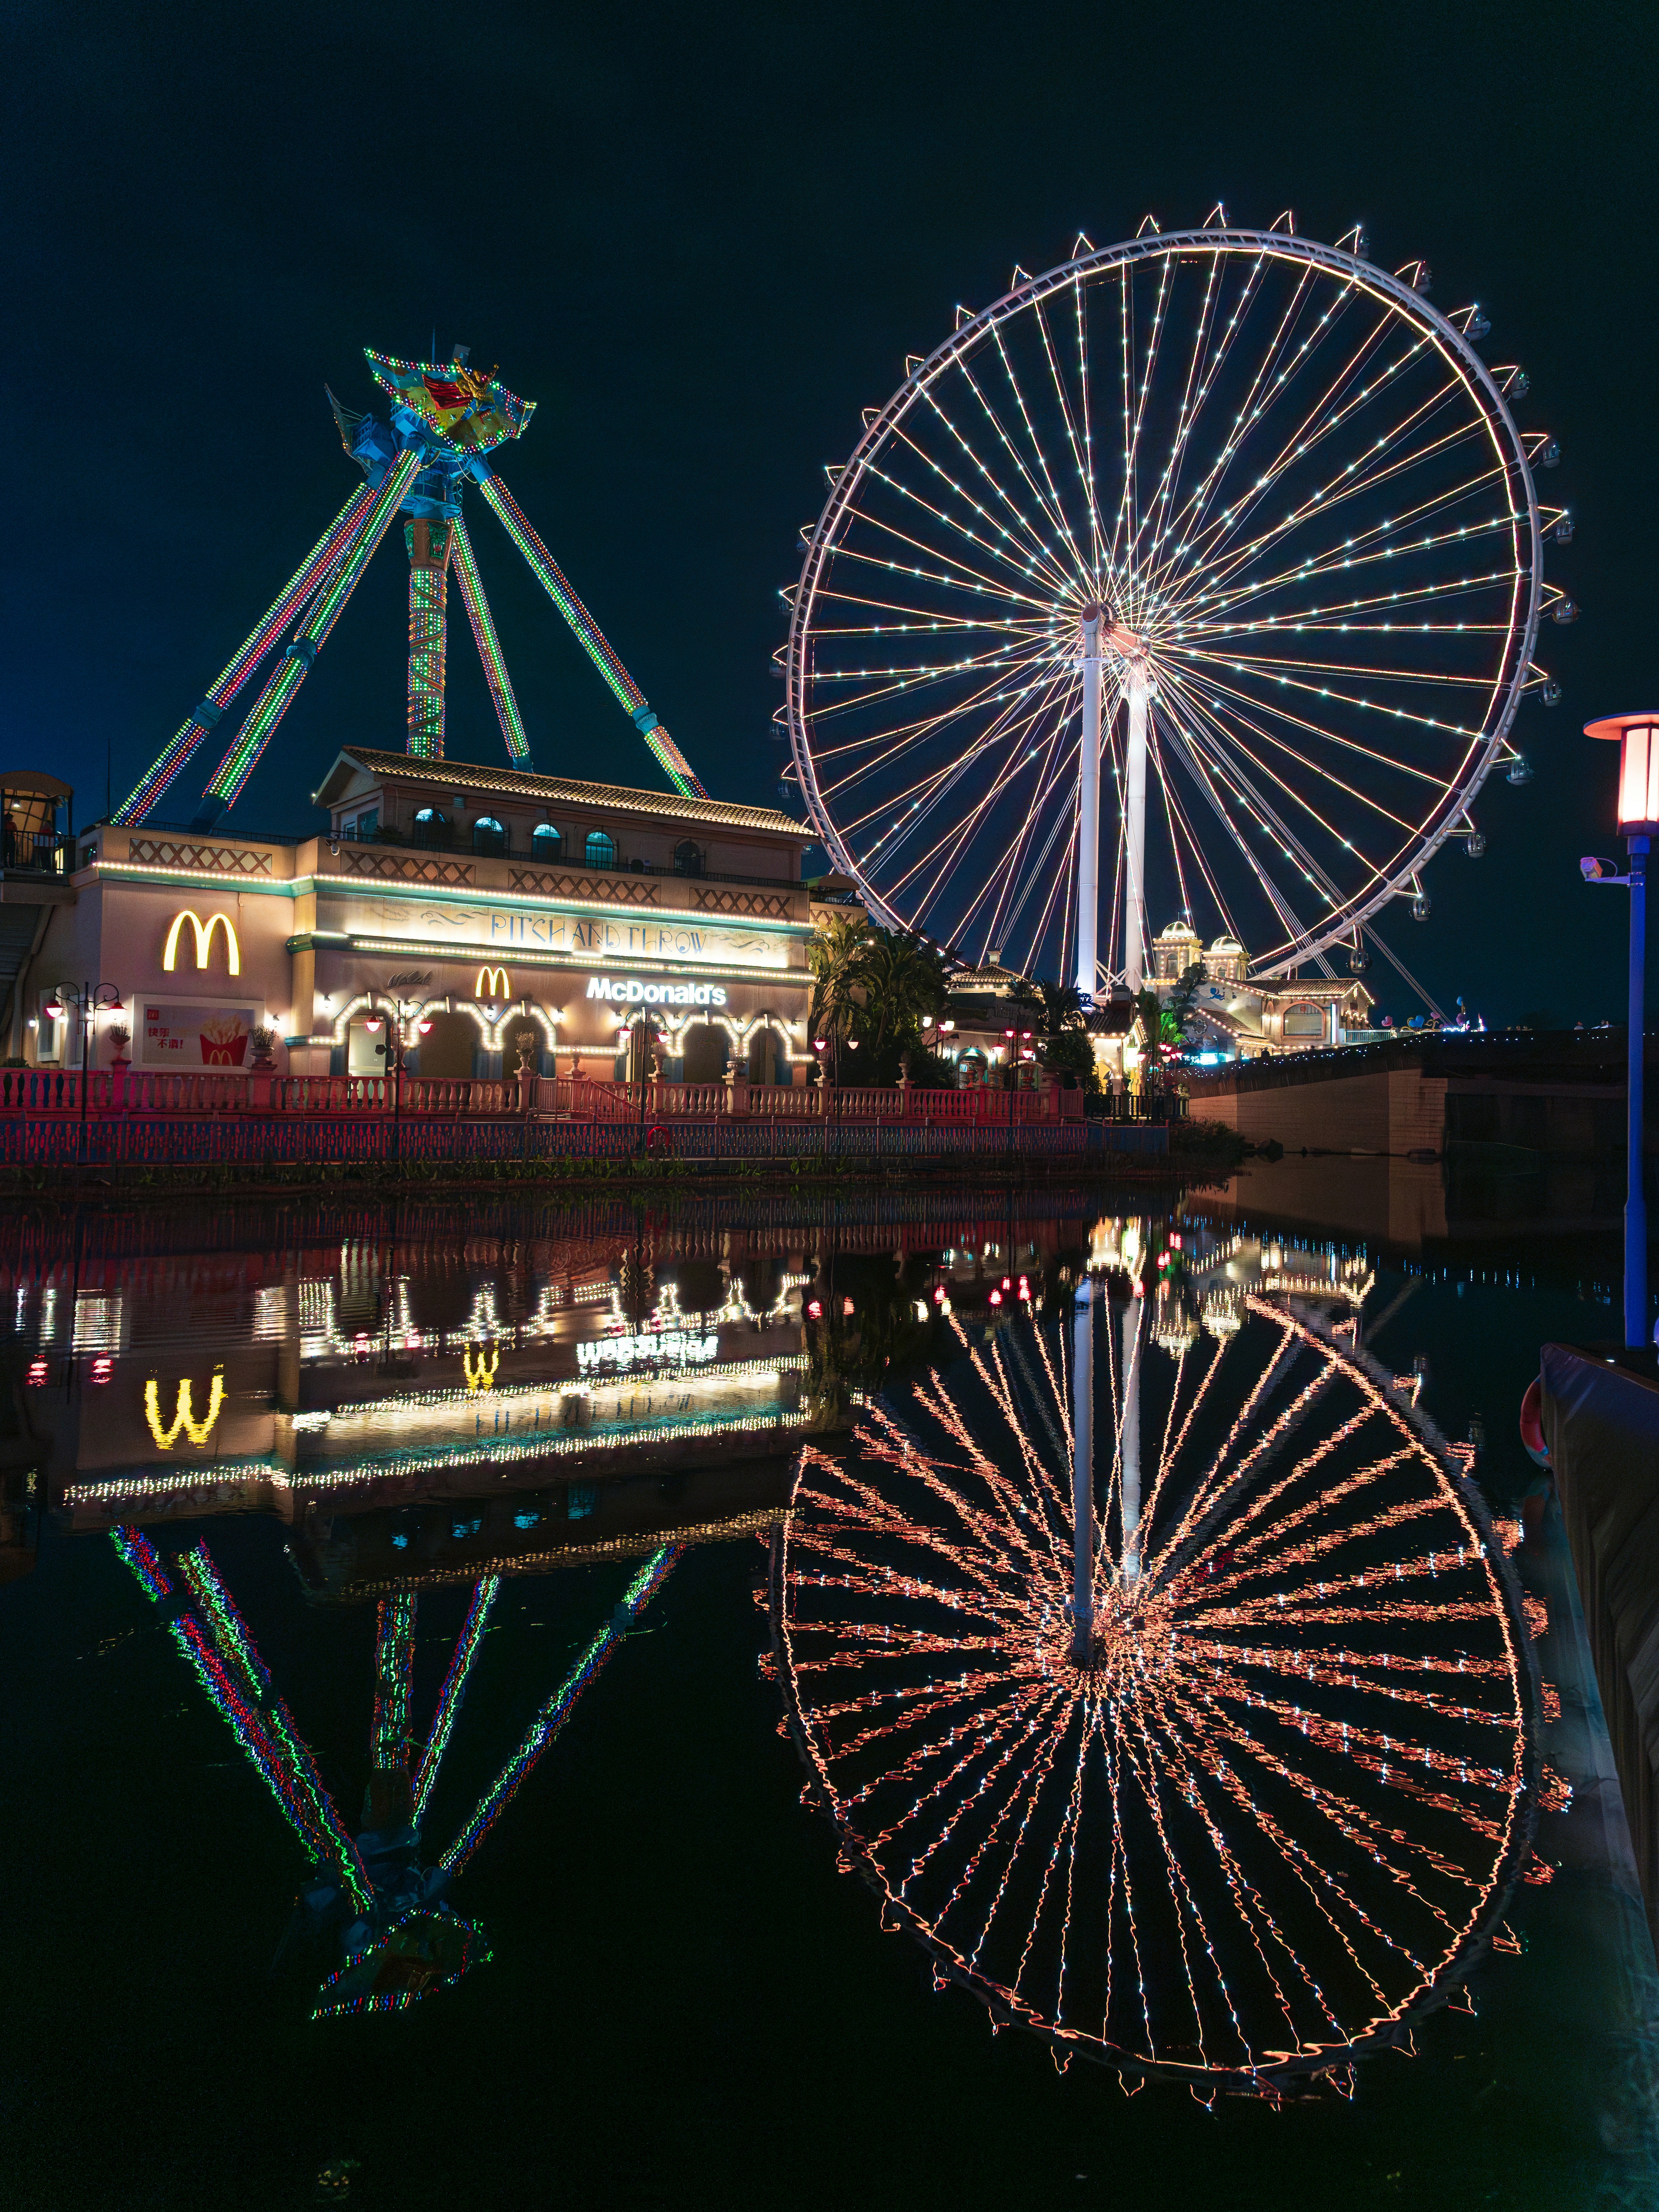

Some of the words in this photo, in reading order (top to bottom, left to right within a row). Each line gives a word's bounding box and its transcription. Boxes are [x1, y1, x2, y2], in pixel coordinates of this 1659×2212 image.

[492, 914, 565, 945] PITCH
[570, 922, 620, 948] AND
[627, 927, 706, 955] THROW
[586, 977, 727, 1006] McDonald's
